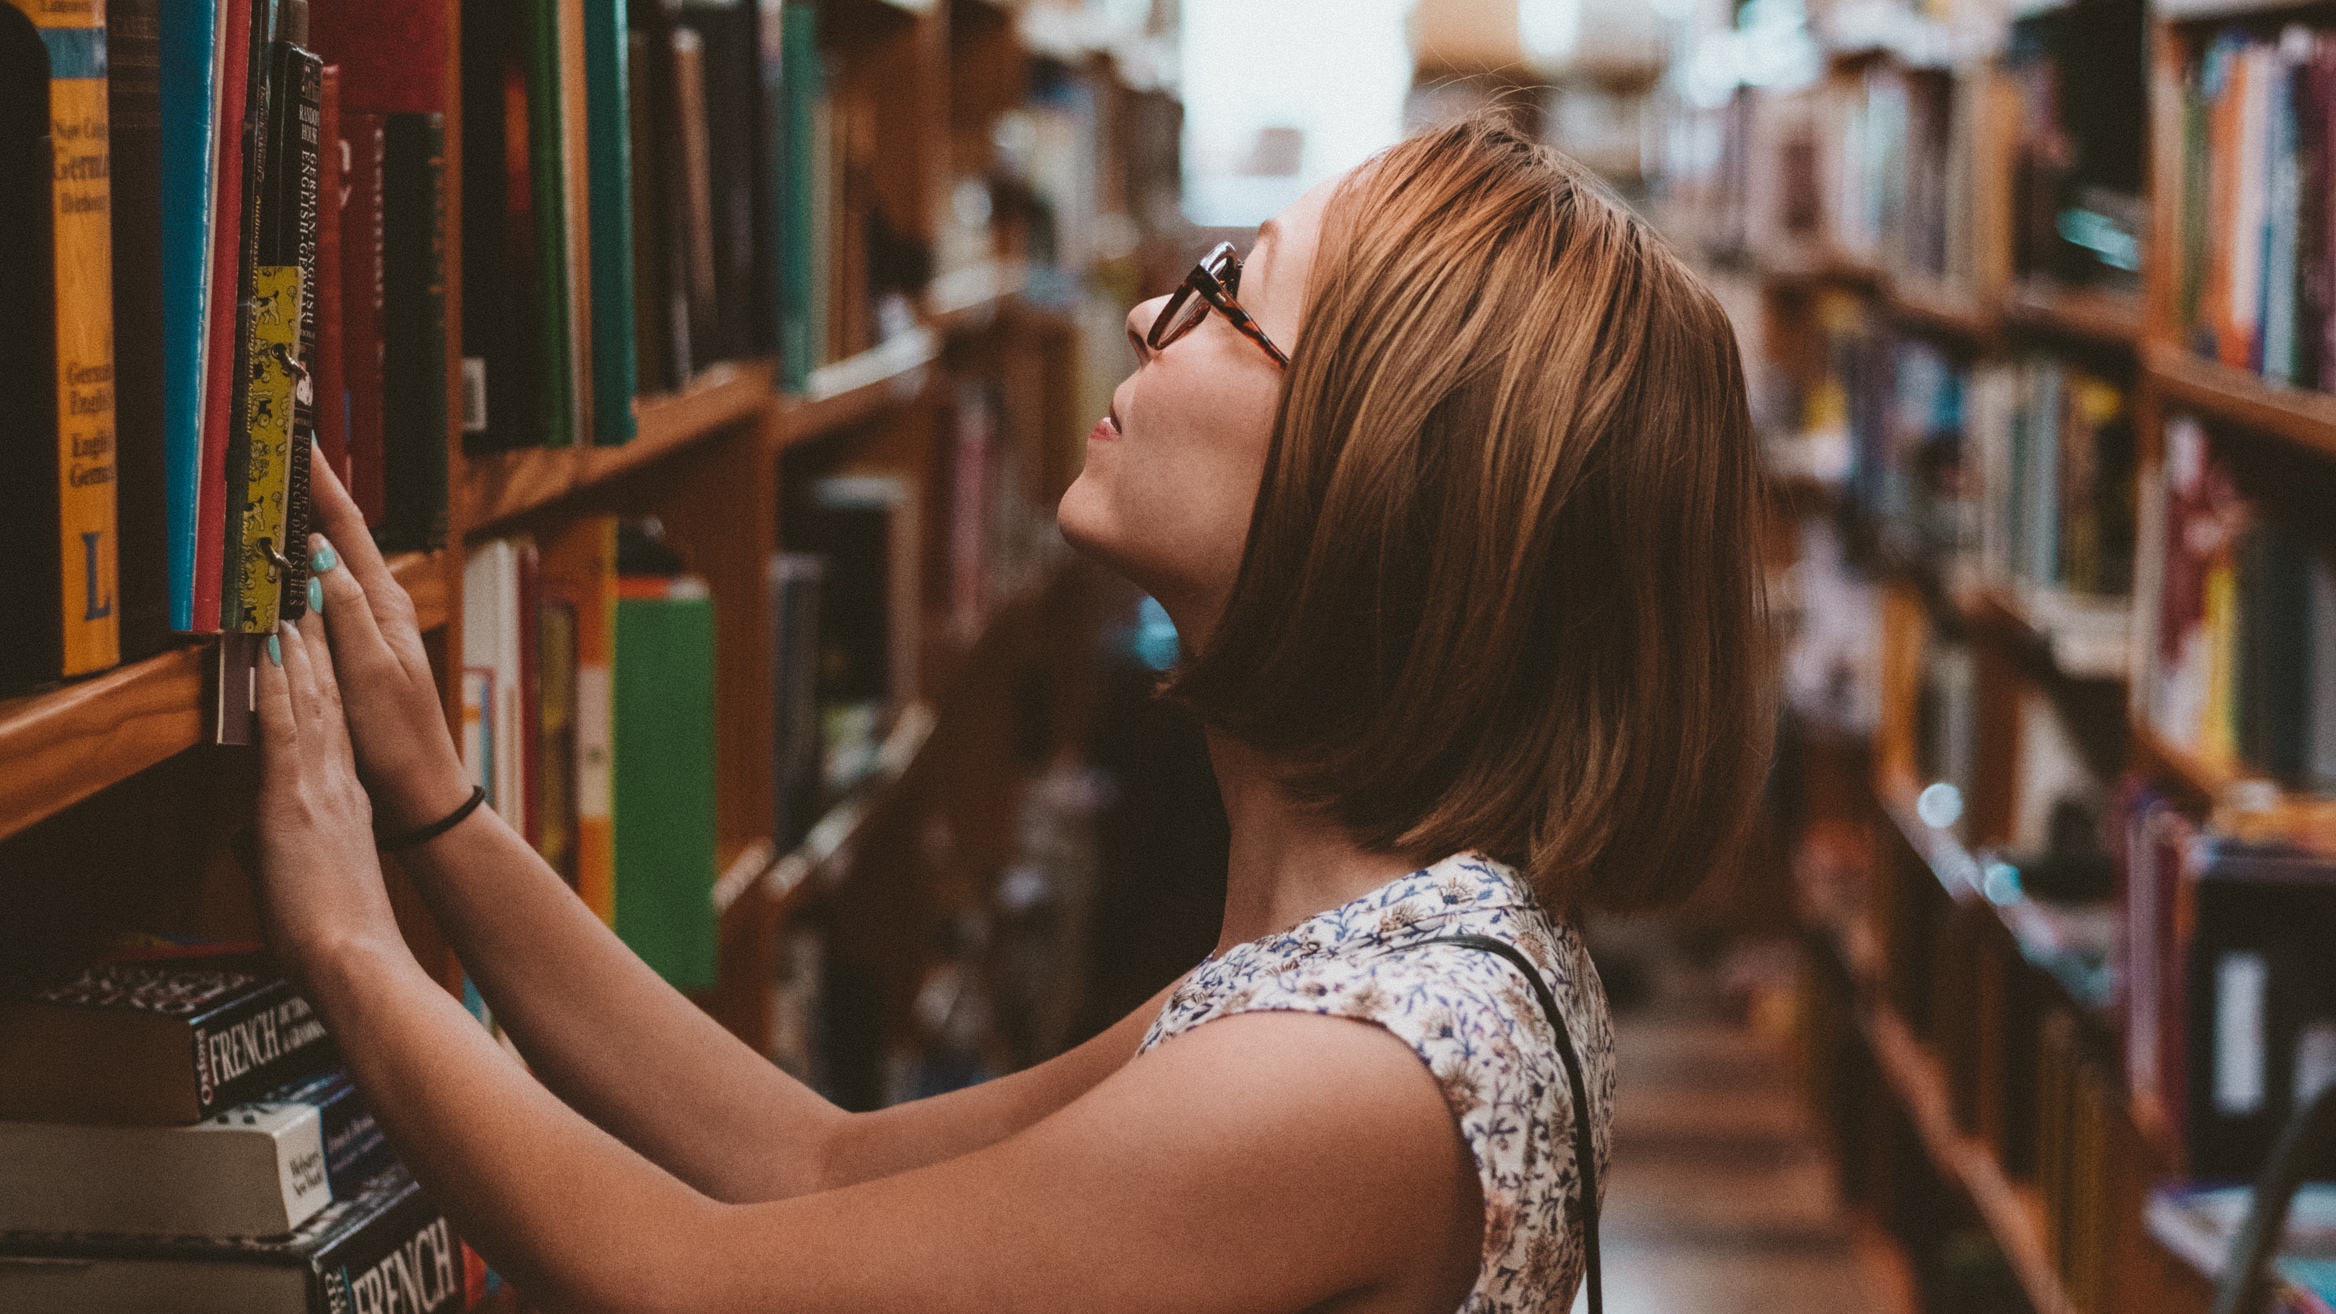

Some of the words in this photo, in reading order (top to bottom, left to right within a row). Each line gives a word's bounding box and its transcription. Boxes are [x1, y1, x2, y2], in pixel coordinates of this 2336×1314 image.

[54, 146, 110, 181] Germa
[306, 152, 318, 324] GERMAN-ENGLISH
[81, 532, 111, 621] L
[208, 1006, 281, 1087] FRENCH
